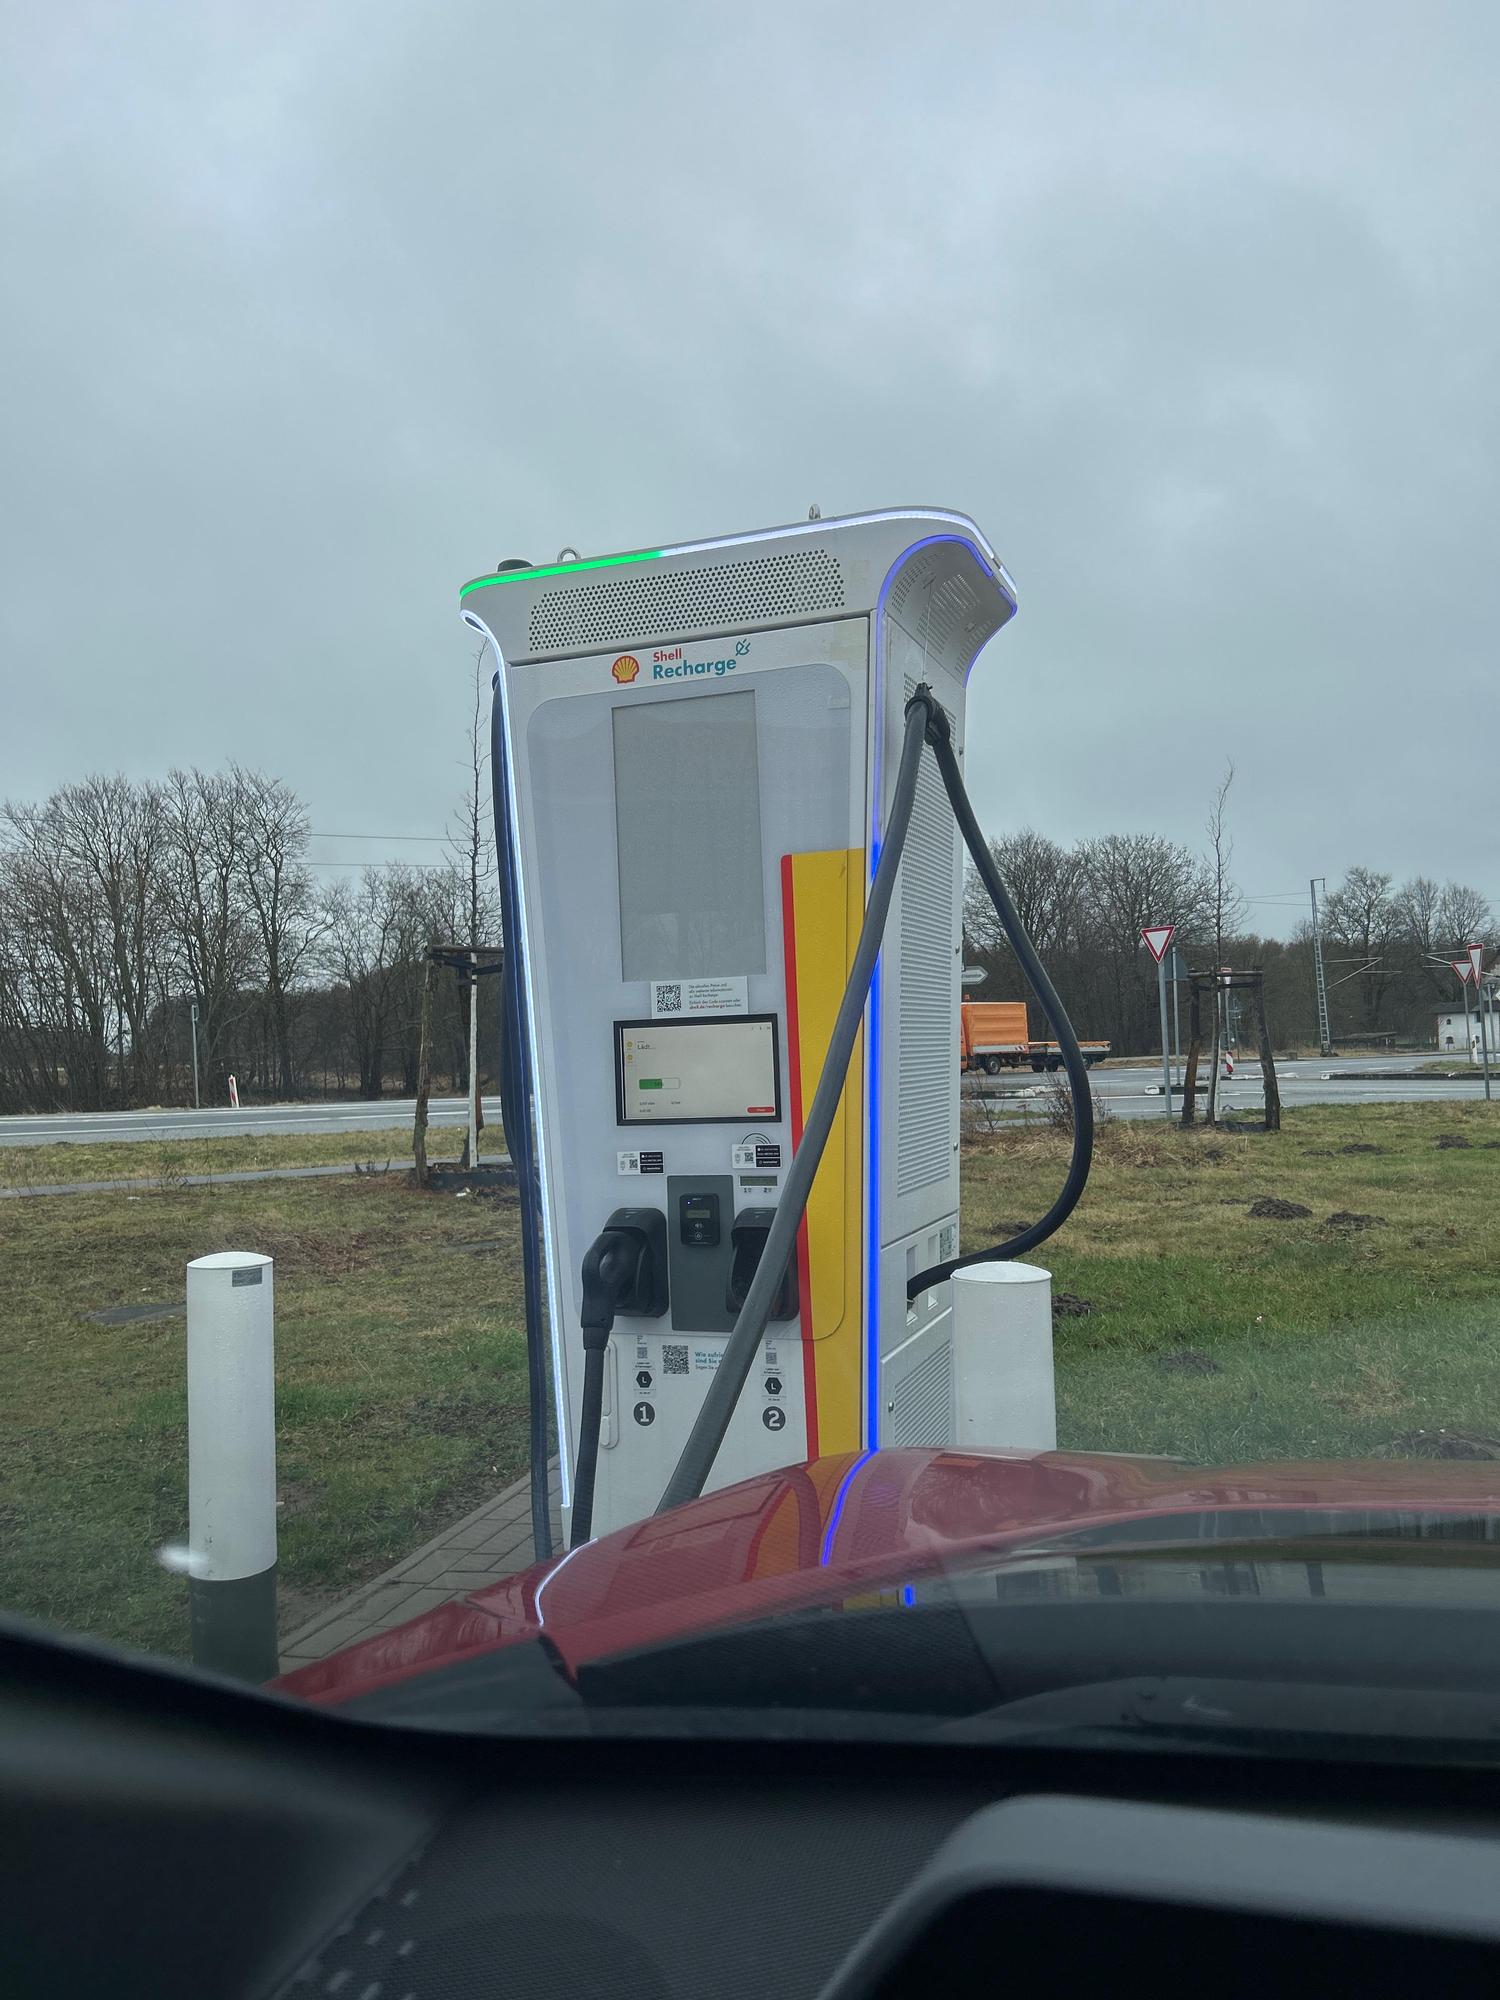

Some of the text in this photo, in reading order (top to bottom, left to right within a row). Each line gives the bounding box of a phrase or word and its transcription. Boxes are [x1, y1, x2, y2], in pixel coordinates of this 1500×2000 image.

[653, 648, 682, 662] Shell
[653, 659, 737, 680] Recharge
[641, 1376, 647, 1384] L
[771, 1382, 776, 1390] L
[640, 1405, 650, 1422] 1
[768, 1409, 780, 1427] 2
